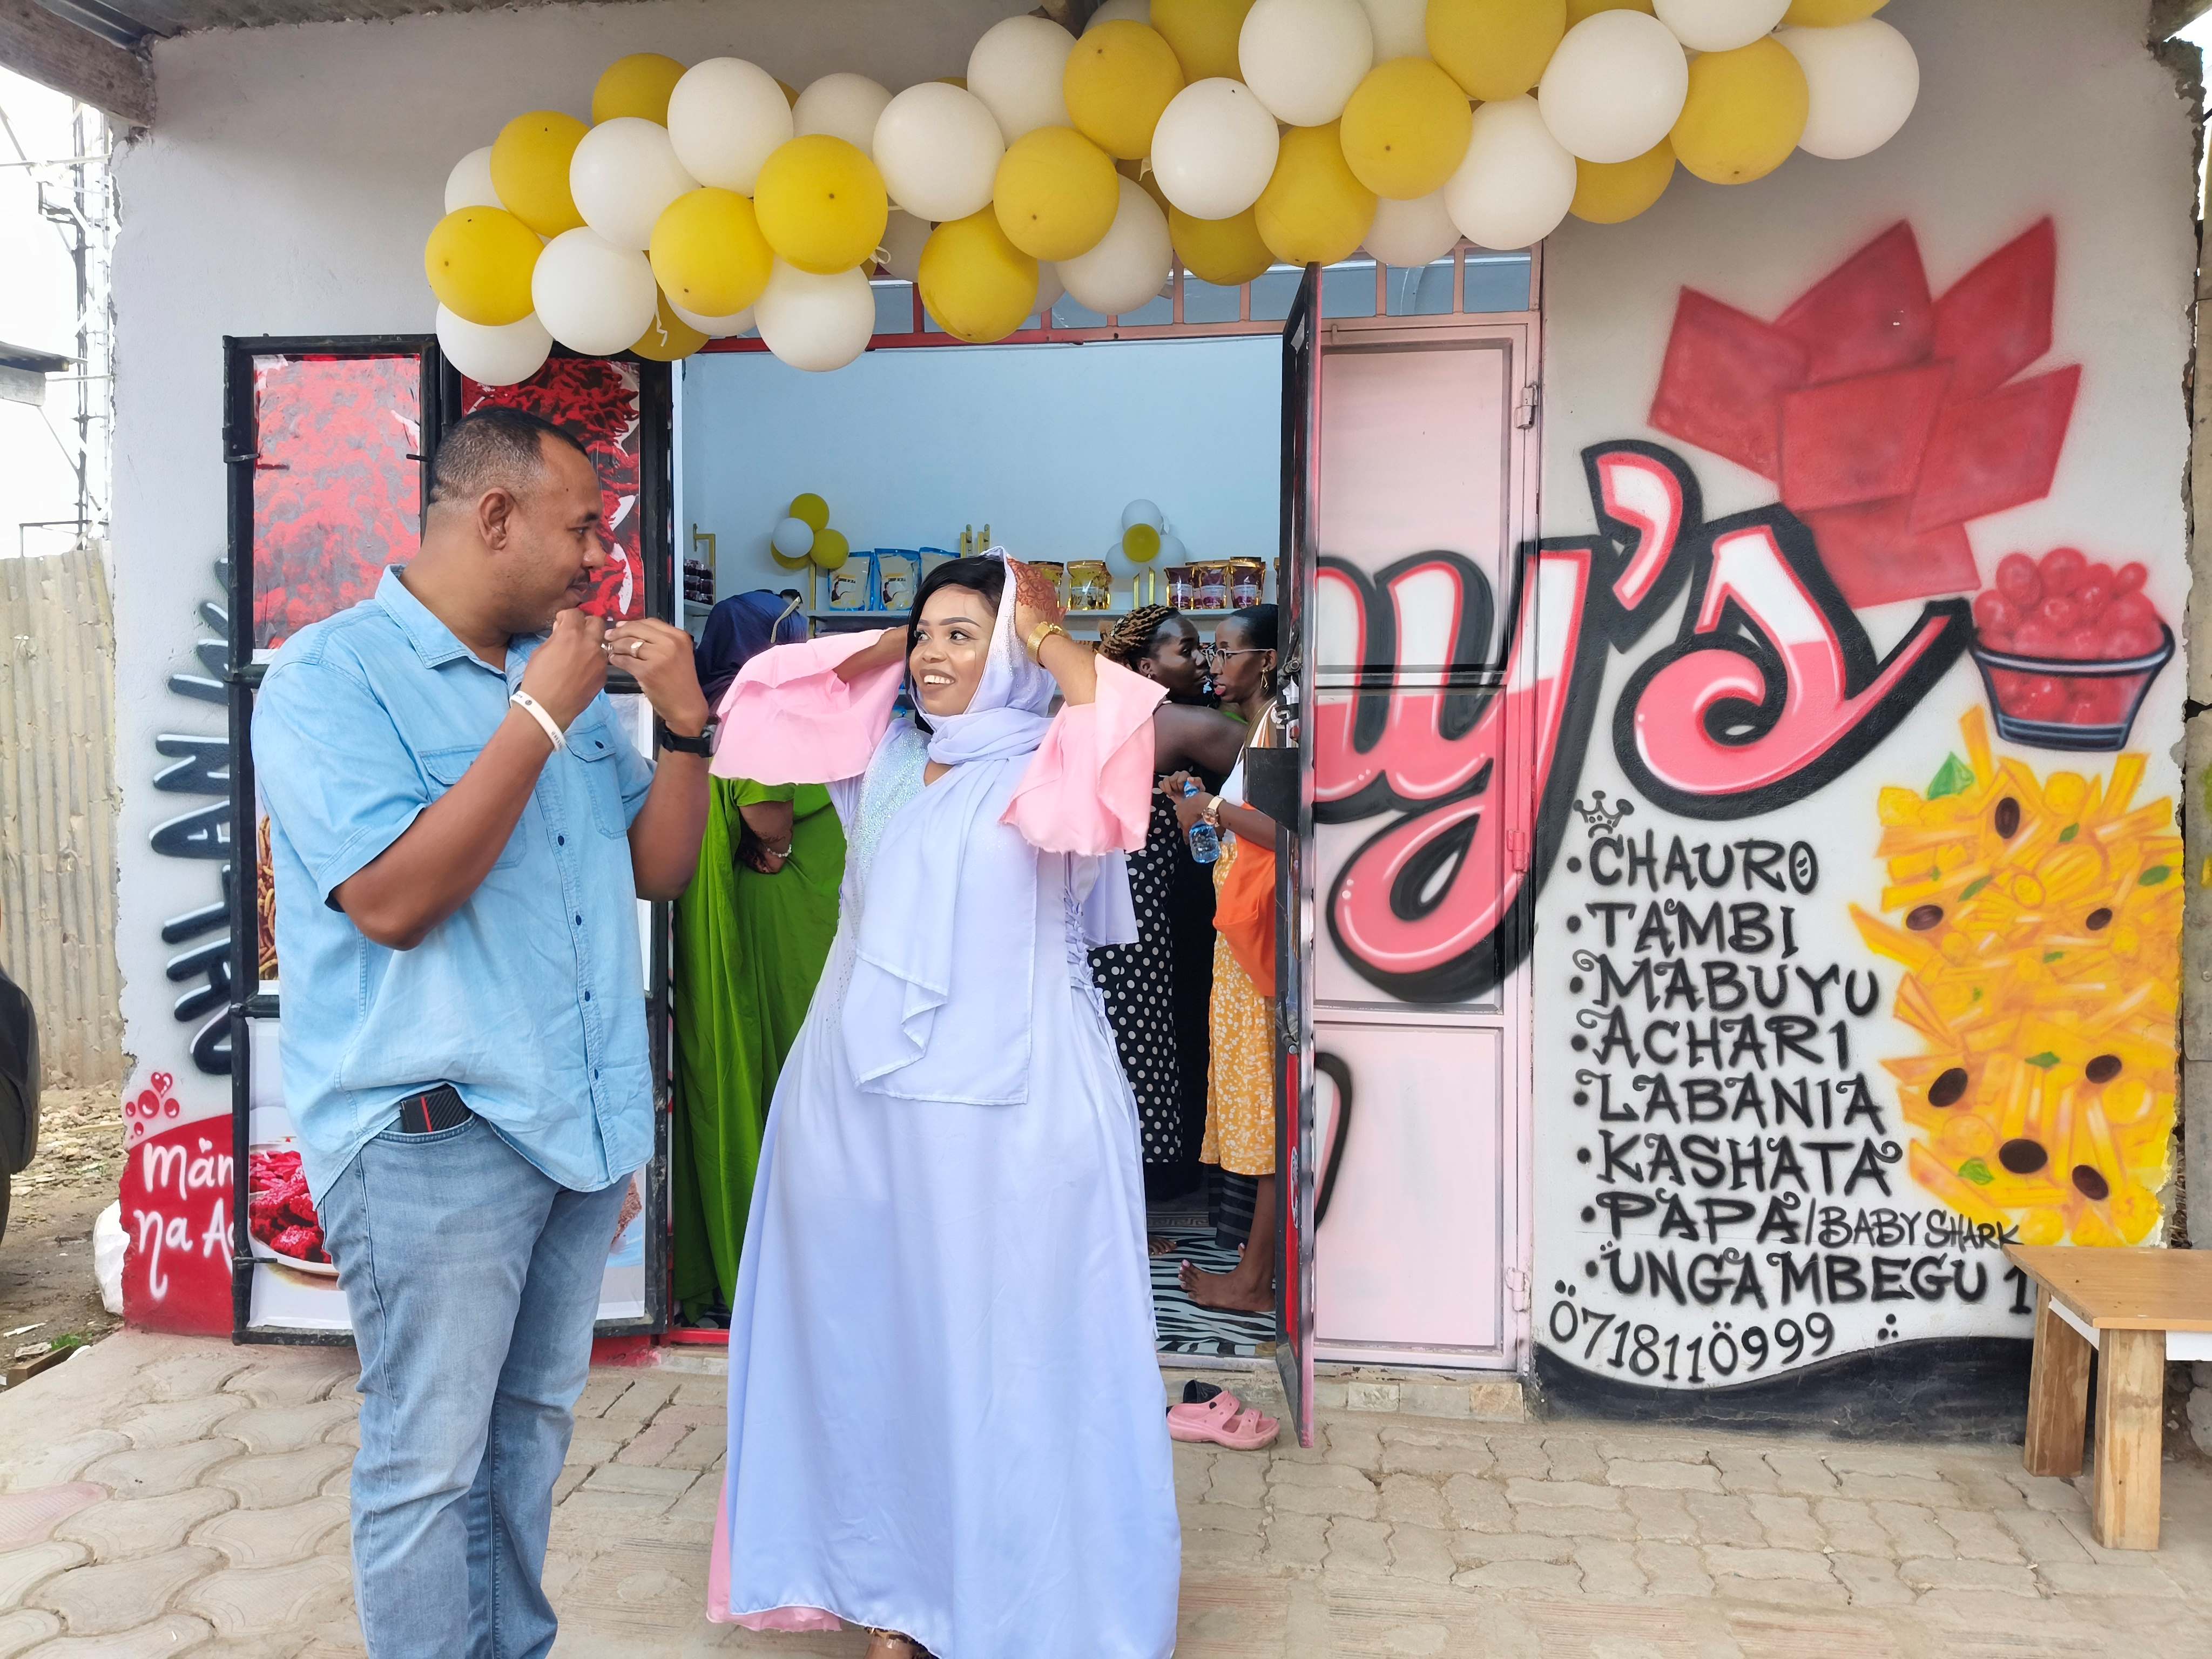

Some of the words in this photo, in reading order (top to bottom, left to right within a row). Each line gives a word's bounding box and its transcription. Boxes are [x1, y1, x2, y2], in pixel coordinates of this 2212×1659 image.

[1585, 898, 1799, 958] TAMBI
[1573, 949, 1880, 1017] MABUYU
[1575, 1068, 1886, 1135] LABANIA
[1596, 1130, 1904, 1197] KASHATA
[1925, 1209, 2025, 1253] SHARK
[1765, 1250, 1988, 1305] MBEGU
